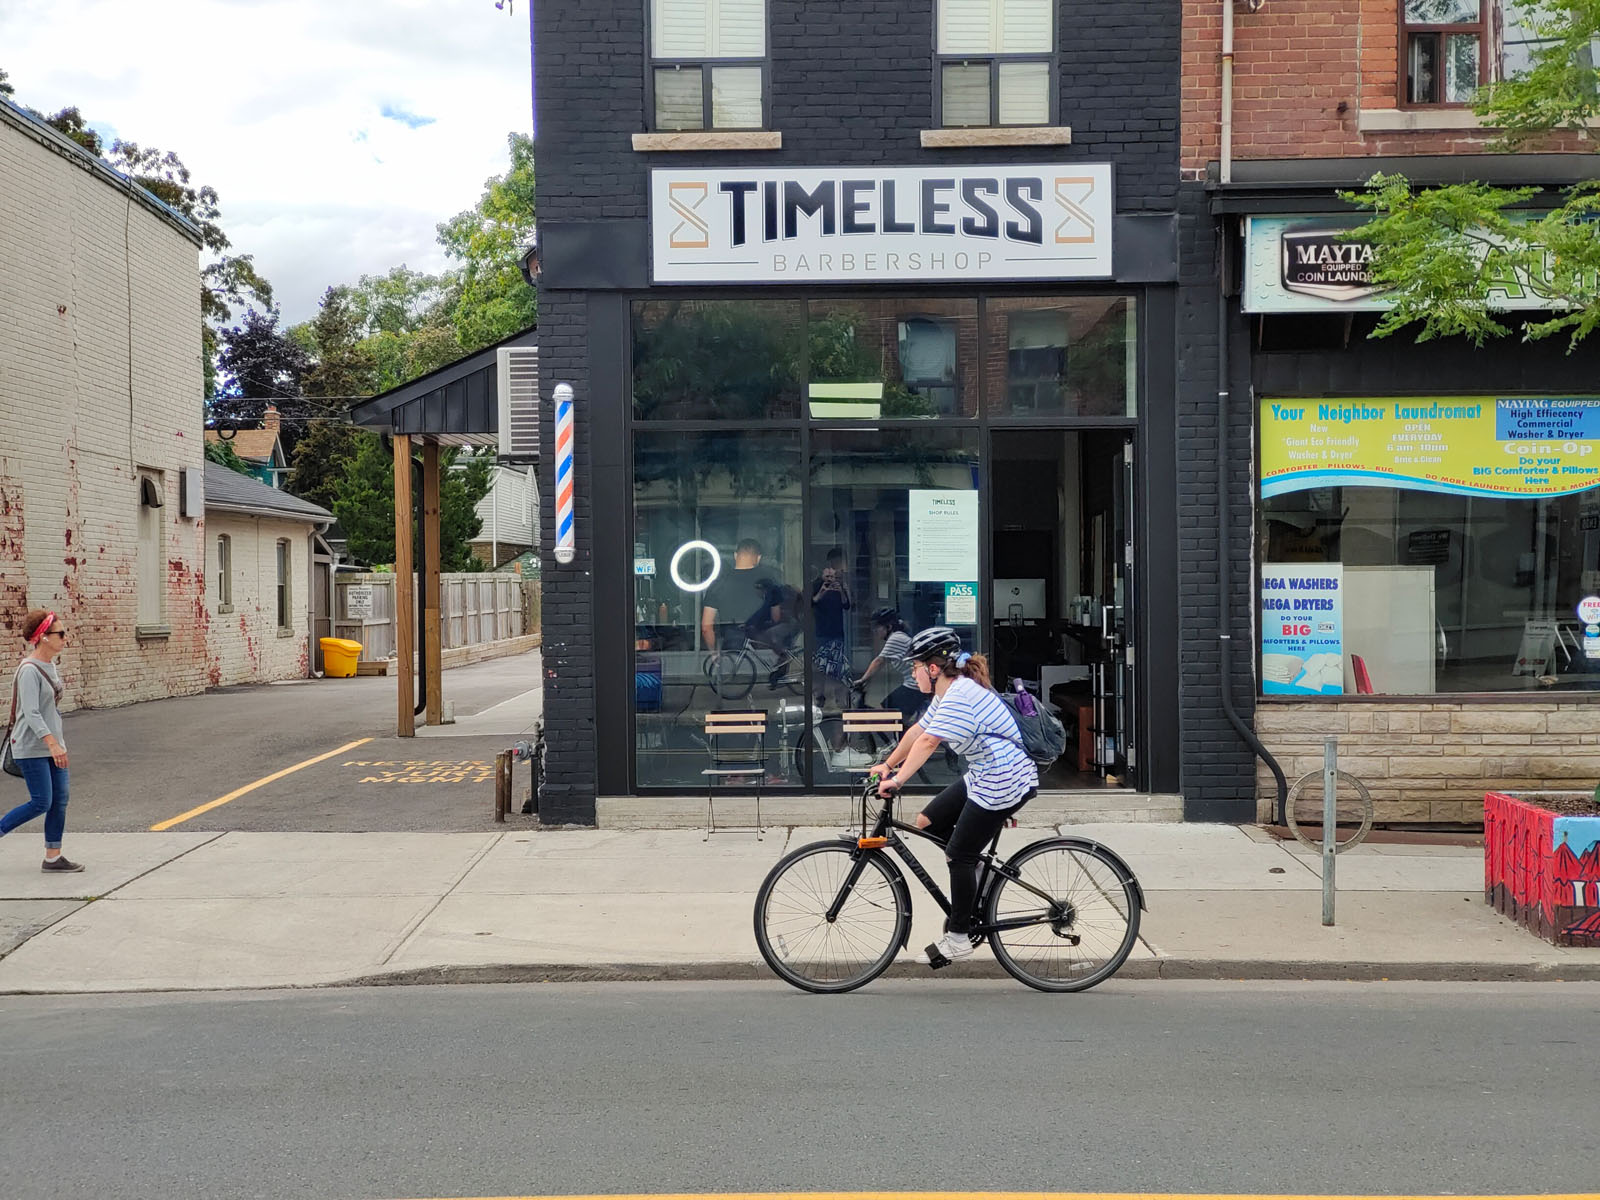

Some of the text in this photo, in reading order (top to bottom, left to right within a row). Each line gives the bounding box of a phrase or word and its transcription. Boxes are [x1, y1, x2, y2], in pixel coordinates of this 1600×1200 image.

[717, 176, 1043, 249] TIMELESS
[1296, 244, 1378, 264] MAYTA
[772, 251, 993, 272] BARBERSHOP
[1297, 272, 1326, 281] COIN
[1497, 400, 1600, 409] MAYTAG EQUIPPED
[1271, 402, 1482, 424] Your Neighbor Laundromat
[1510, 410, 1533, 419] High
[1517, 420, 1573, 428] Commercial
[1392, 433, 1443, 441] EVERYDAY
[1507, 429, 1584, 439] Washer & Dryer
[1504, 441, 1593, 457] Coin-Op
[1519, 456, 1561, 466] Do your
[1266, 463, 1318, 477] COMFORTER
[1473, 466, 1599, 475] BIG Comforter & Pillows
[1441, 476, 1465, 485] MORE
[1469, 481, 1511, 492] LAUNDRY
[1524, 476, 1550, 485] Here
[1289, 578, 1339, 590] WASHERS
[951, 586, 973, 596] PASS
[1293, 599, 1334, 611] DRYERS
[1282, 624, 1312, 636] BIG
